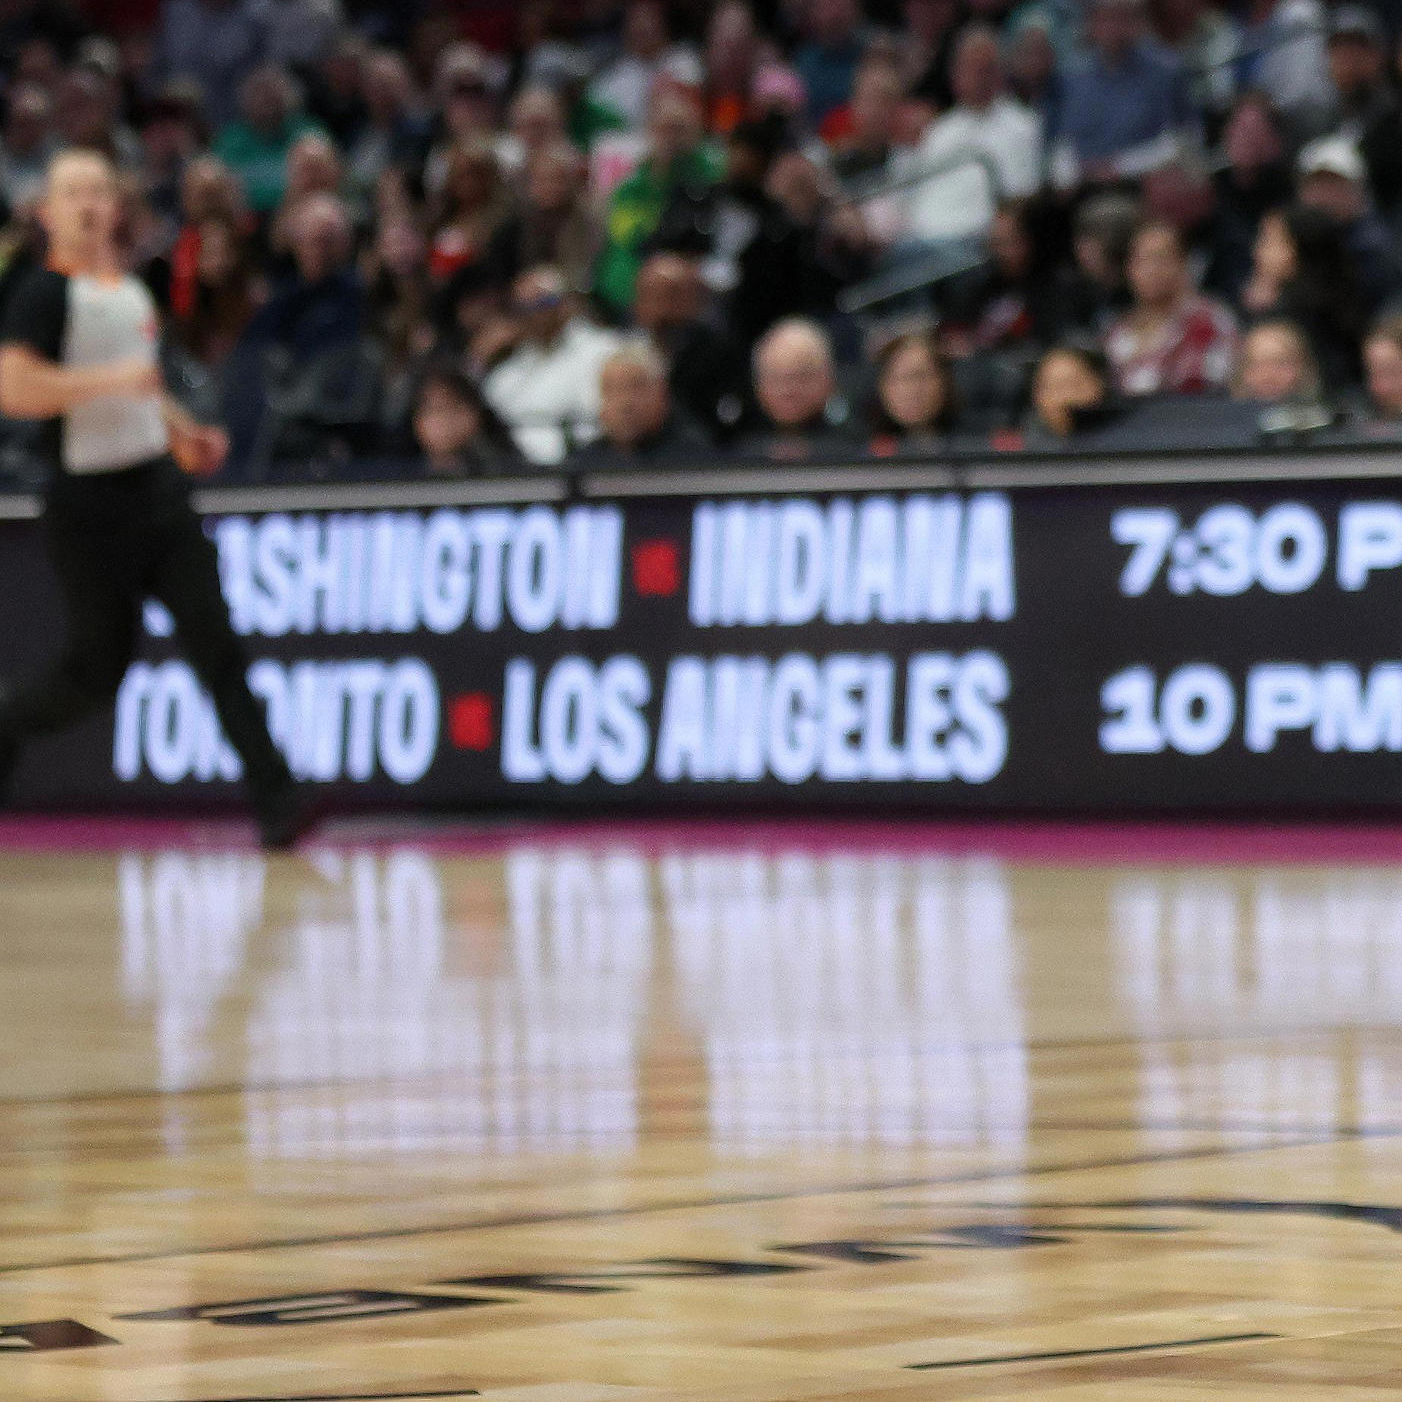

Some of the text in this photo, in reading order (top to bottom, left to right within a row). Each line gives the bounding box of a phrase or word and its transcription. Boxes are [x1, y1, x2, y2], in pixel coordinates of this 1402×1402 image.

[202, 494, 1015, 636] ASHINGTON INDIANA
[1112, 504, 1327, 596] 7:30
[502, 657, 650, 784] LOS
[656, 651, 1010, 784] ANGELES
[1100, 665, 1235, 755] 10
